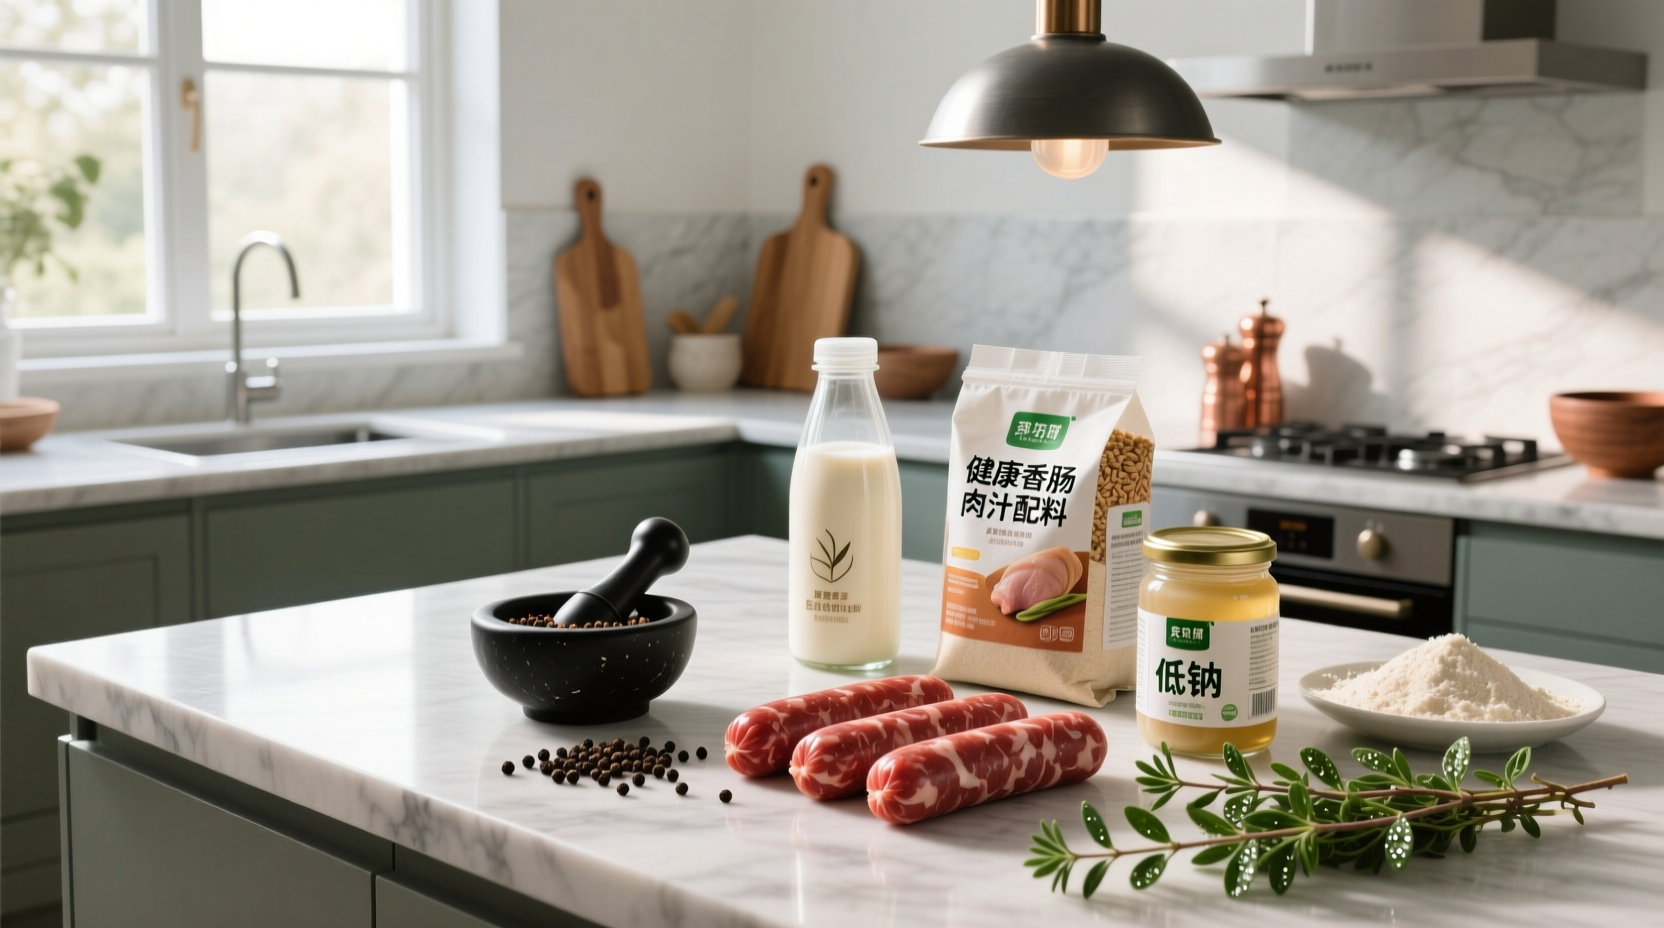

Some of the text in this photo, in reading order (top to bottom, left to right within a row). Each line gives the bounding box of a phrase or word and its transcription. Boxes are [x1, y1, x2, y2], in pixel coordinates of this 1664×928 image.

[966, 454, 1077, 494] 健康香肠
[961, 488, 1067, 528] 肉汁配料
[1155, 658, 1222, 698] 低钠
